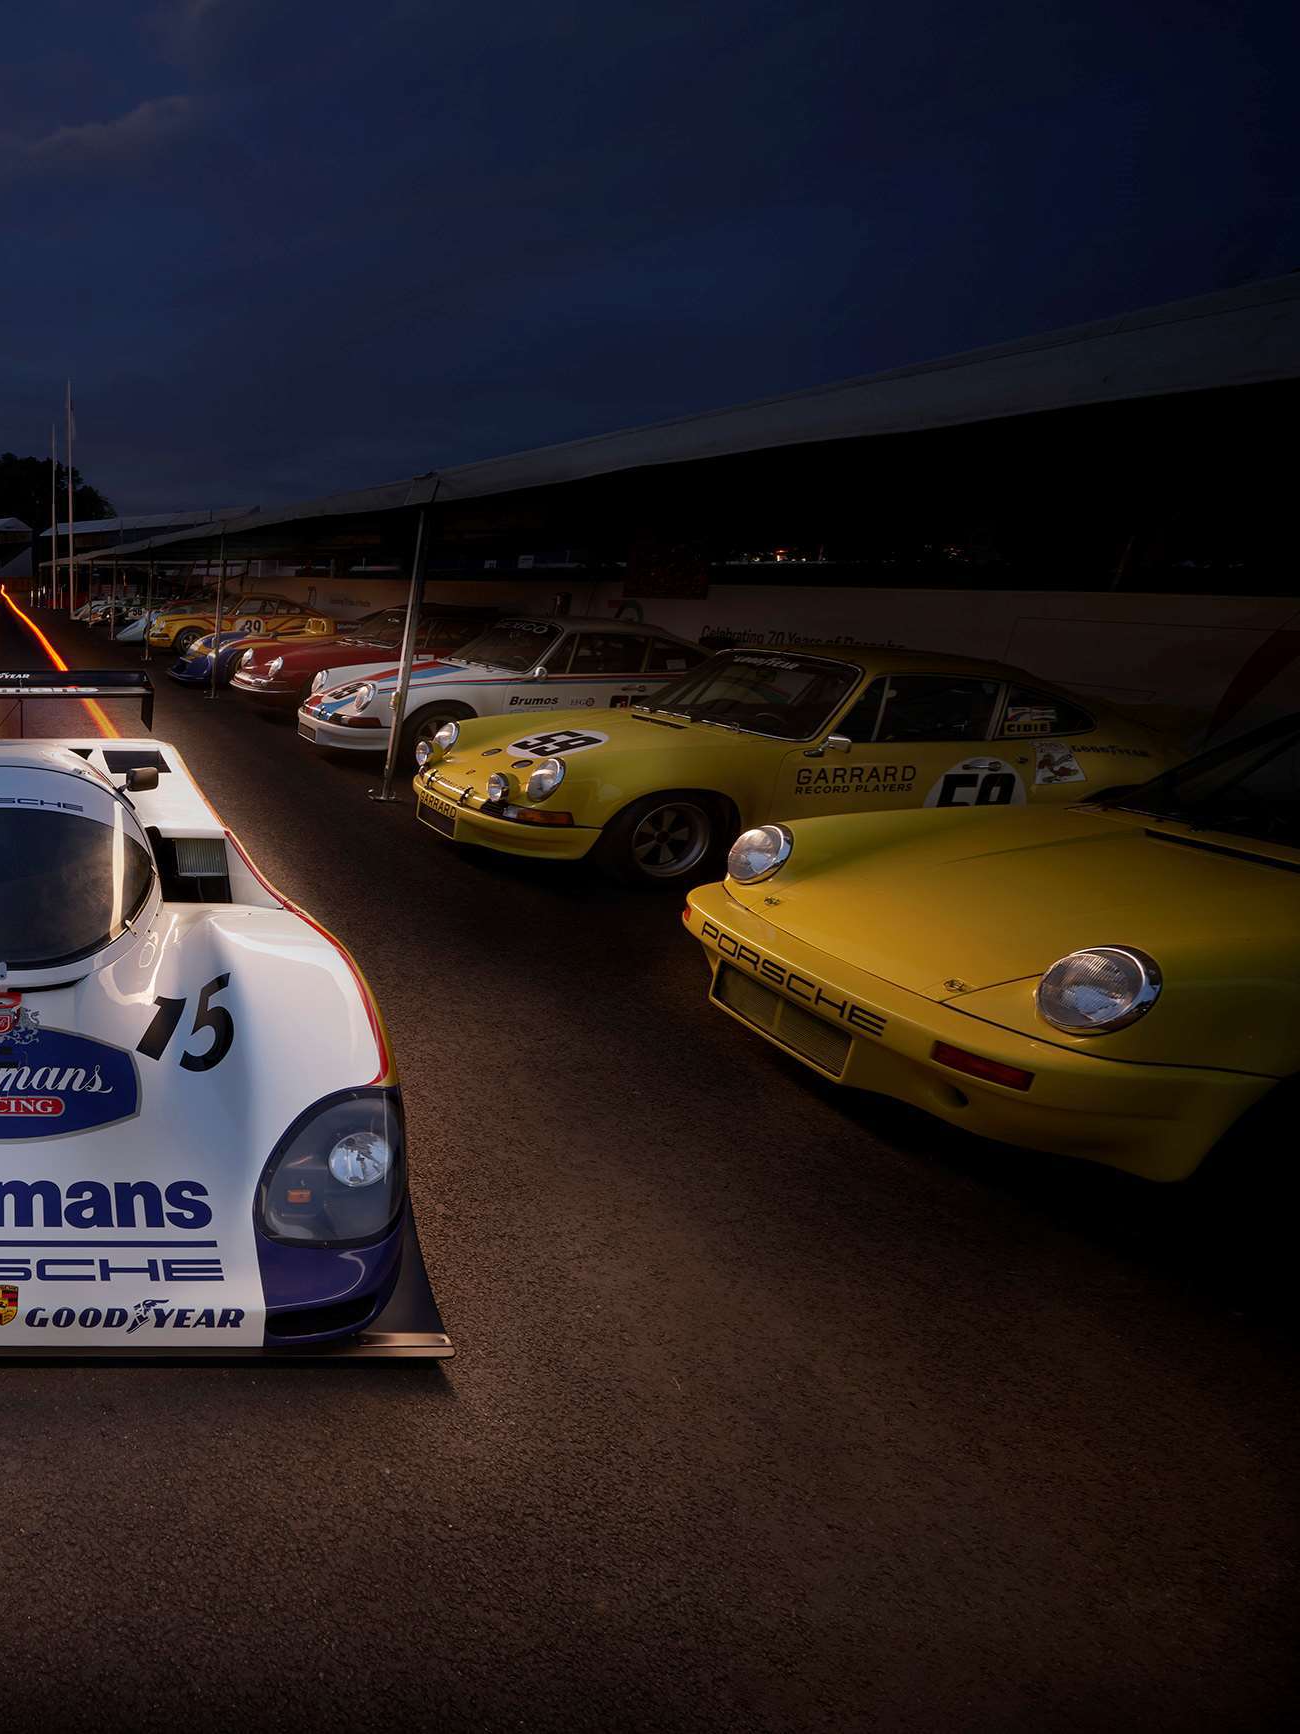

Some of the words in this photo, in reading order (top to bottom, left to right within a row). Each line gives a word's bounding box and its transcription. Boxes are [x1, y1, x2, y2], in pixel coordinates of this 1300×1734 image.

[509, 696, 559, 706] Brumos
[511, 730, 603, 757] 59
[796, 765, 917, 785] GARRARD
[795, 784, 851, 796] RECORD
[854, 783, 913, 794] PLAYERS
[419, 790, 457, 818] GARRARD
[701, 921, 887, 1038] PORSCHE
[136, 972, 235, 1072] 15
